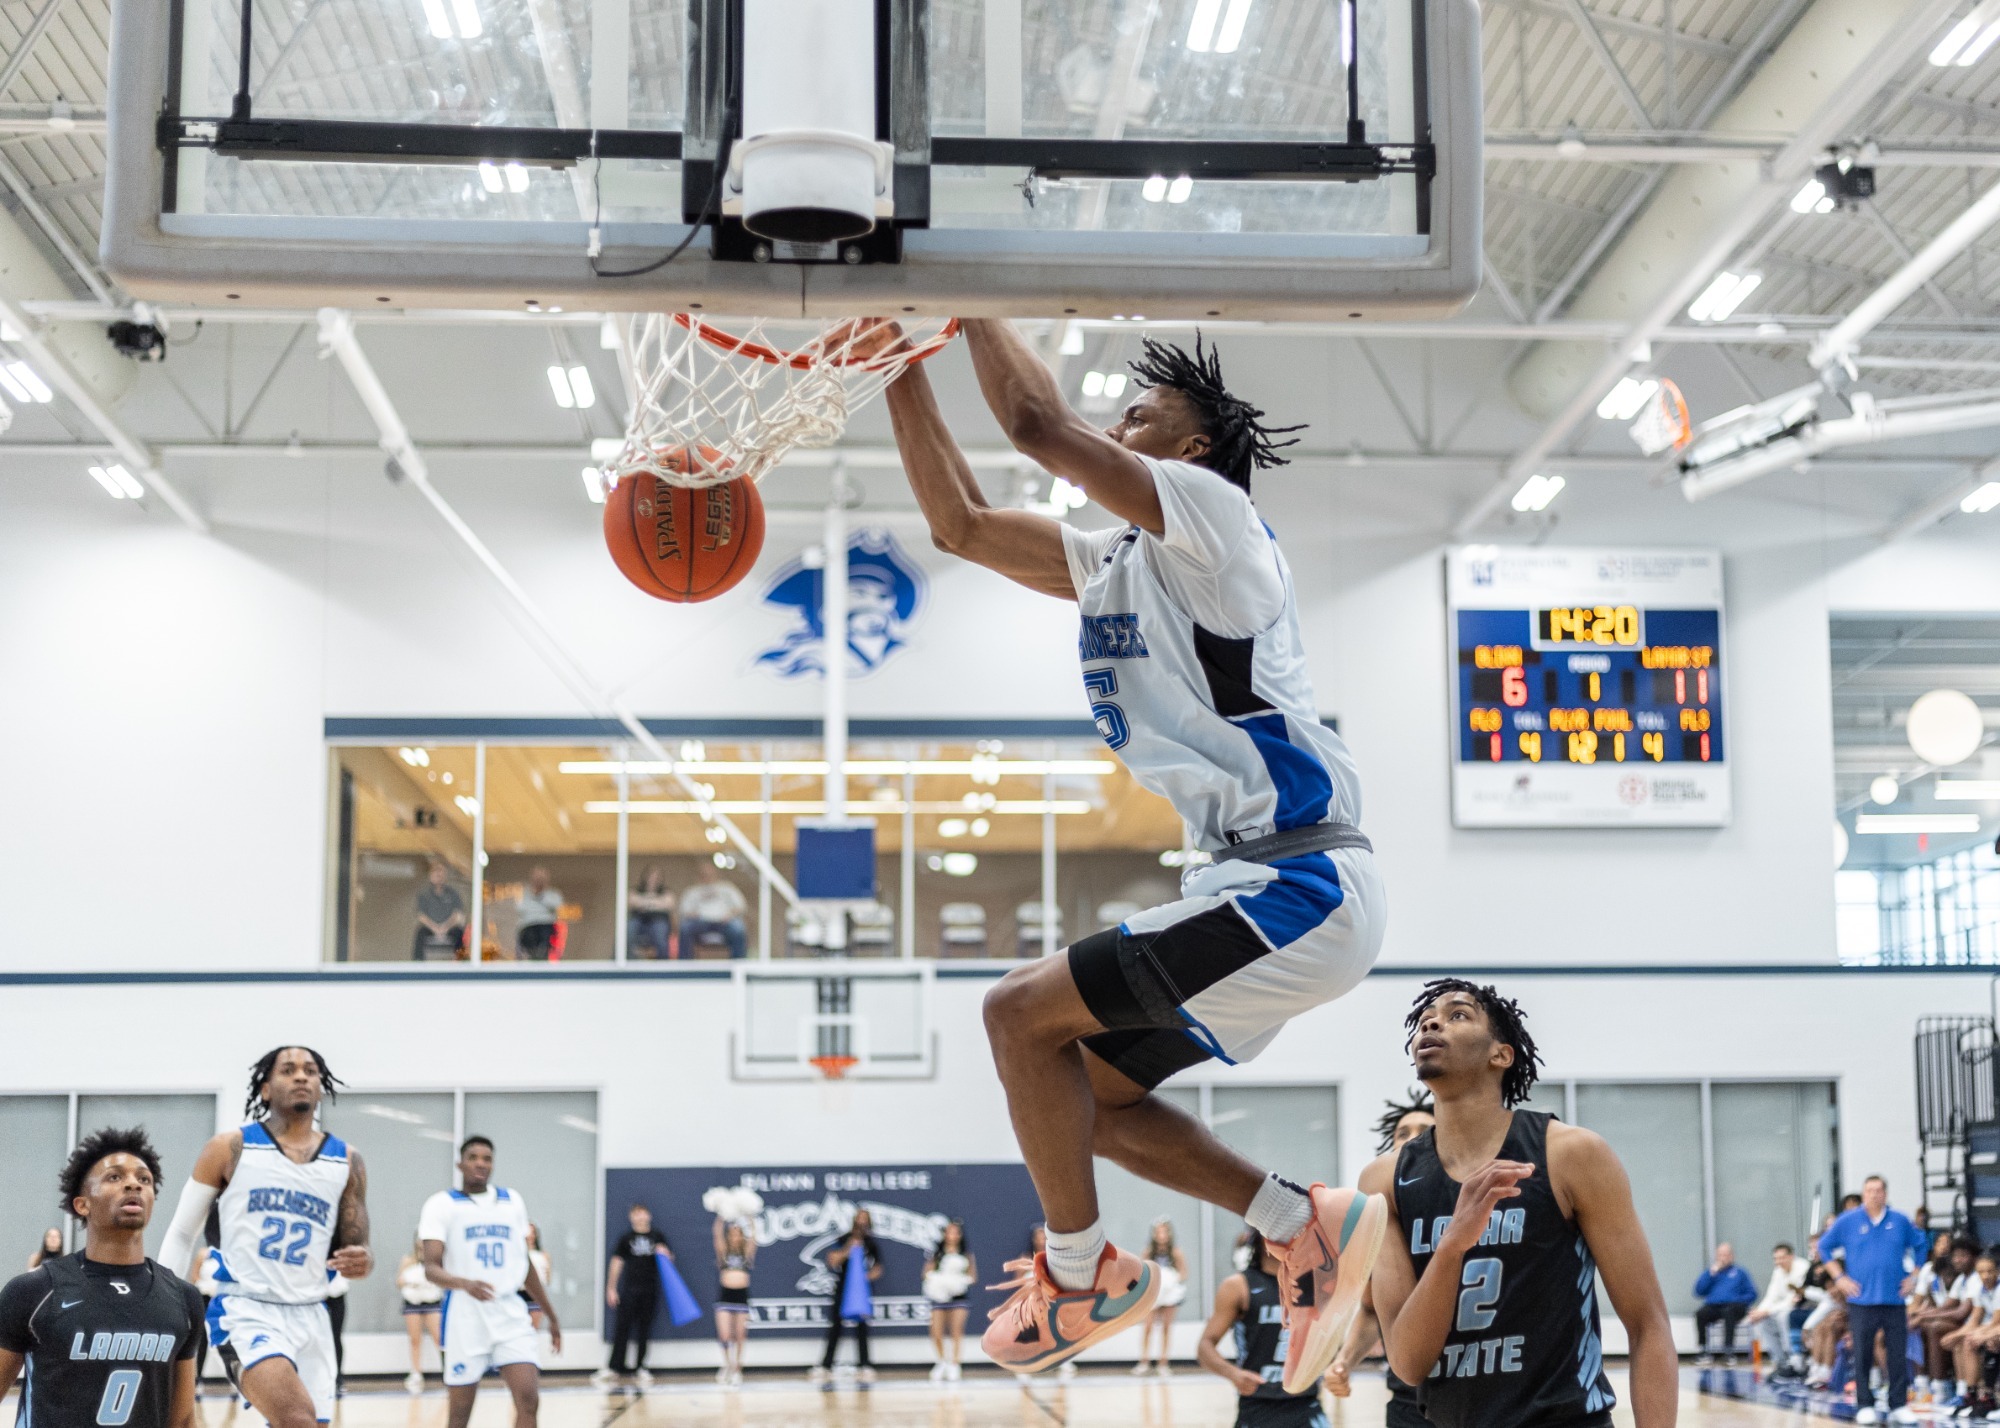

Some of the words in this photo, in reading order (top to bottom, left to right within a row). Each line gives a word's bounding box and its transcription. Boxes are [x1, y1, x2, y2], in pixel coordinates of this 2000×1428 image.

[656, 458, 683, 560] SPALDIG
[1550, 605, 1638, 645] 14:20
[1502, 666, 1528, 707] 6
[1589, 672, 1601, 702] 1
[1674, 669, 1708, 704] 11
[1490, 732, 1502, 763] 1
[1519, 732, 1541, 763] 4
[1568, 730, 1598, 764] 12
[1613, 732, 1625, 763] 1
[1642, 732, 1664, 763] 4
[1699, 732, 1711, 763] 1
[741, 1172, 816, 1192] BLINN
[824, 1170, 932, 1191] COLLEGE
[258, 1216, 312, 1266] 22
[476, 1243, 504, 1267] 40
[1456, 1257, 1504, 1331] 2
[69, 1332, 176, 1362] LAMAR
[96, 1370, 143, 1426] 0
